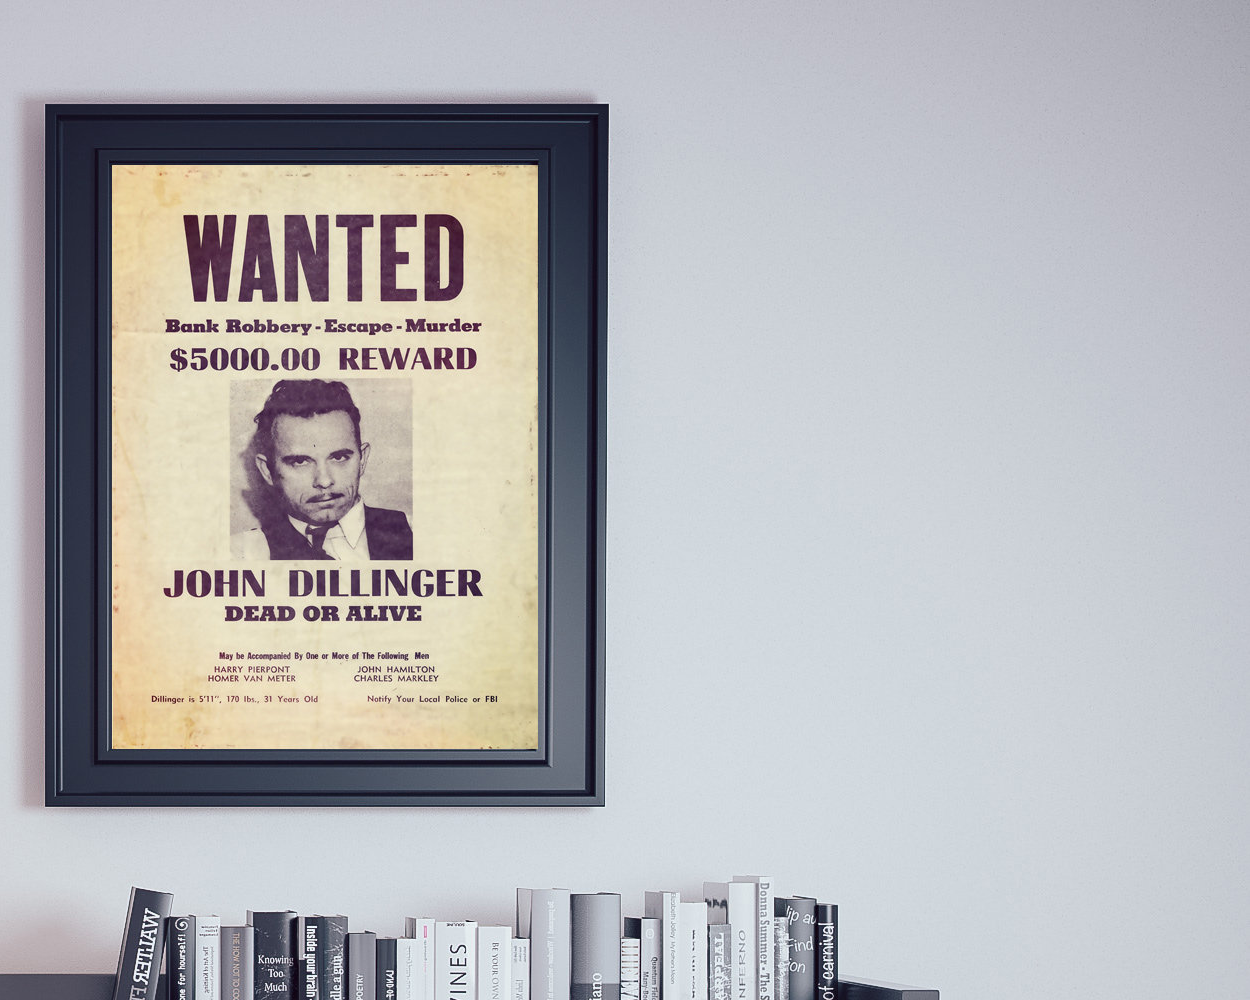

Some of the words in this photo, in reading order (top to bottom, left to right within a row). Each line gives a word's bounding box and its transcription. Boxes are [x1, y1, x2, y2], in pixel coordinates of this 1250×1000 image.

[183, 213, 465, 303] WANTED
[165, 319, 219, 334] Bank
[225, 319, 313, 336] Robbery
[324, 319, 393, 336] Escape
[405, 319, 483, 334] Murder
[169, 347, 321, 373] $5000.00
[339, 347, 478, 371] REWARD
[163, 569, 266, 598] JOHN
[288, 568, 484, 598] DILLINGER
[224, 605, 296, 622] DEAD
[302, 605, 340, 622] OR
[345, 605, 422, 622] ALIVE
[219, 652, 234, 662] May
[236, 652, 245, 660] be
[247, 652, 292, 662] Accompanied
[294, 652, 304, 661] By
[306, 652, 319, 660] One
[331, 652, 350, 660] More
[352, 652, 360, 660] of
[362, 652, 375, 660] The
[377, 652, 410, 662] Following
[414, 652, 430, 660] Men
[207, 674, 240, 682] HOMER
[243, 674, 263, 682] VAN
[267, 674, 296, 682] METER
[214, 666, 244, 674] HARRY
[247, 666, 291, 674] PIERPONT
[353, 674, 393, 682] CHARLES
[397, 674, 439, 682] MARKLEY
[357, 666, 382, 674] JOHN
[386, 666, 435, 674] HAMILTON
[151, 696, 185, 705] Dillinger
[367, 696, 392, 705] Notify
[759, 882, 770, 918] Donna
[232, 932, 240, 945] THE
[306, 925, 319, 952] Inside
[759, 919, 770, 965] Summer
[232, 946, 240, 962] HOW
[818, 922, 834, 980] carnival
[258, 954, 294, 966] Knowing
[304, 953, 317, 974] your
[332, 955, 344, 976] gun
[232, 963, 240, 978] NOT
[267, 968, 284, 978] Too
[650, 956, 659, 985] Quantum
[178, 972, 187, 986] for
[232, 979, 240, 987] TO
[306, 975, 319, 998] brain
[355, 973, 364, 1000] POETRY
[759, 973, 770, 993] The
[264, 983, 288, 992] Much
[818, 985, 834, 1000] of
